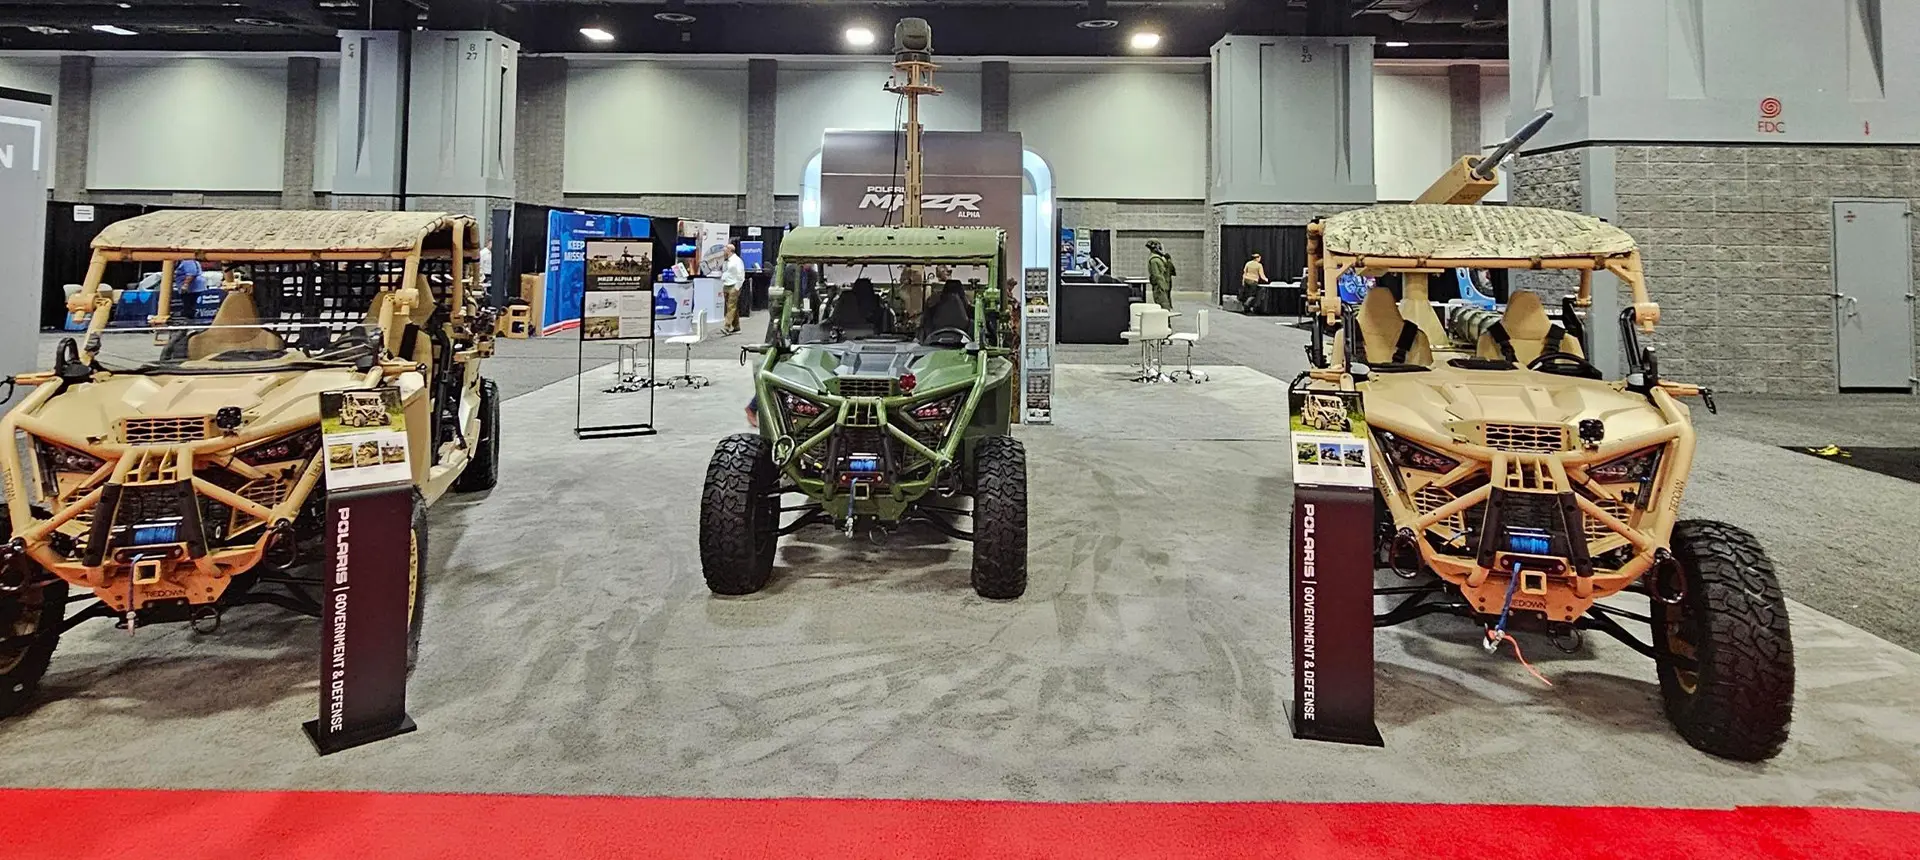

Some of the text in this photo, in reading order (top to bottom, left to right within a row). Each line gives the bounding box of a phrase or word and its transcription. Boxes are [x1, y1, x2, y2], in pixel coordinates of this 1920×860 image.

[466, 52, 478, 60] 27
[1301, 54, 1313, 63] 23
[1758, 121, 1785, 133] FDC
[567, 241, 585, 250] KEEP
[335, 507, 350, 585] POLARIS
[1303, 504, 1315, 578] POLARIS
[1510, 599, 1547, 609] IEDOWN
[1303, 587, 1315, 660] GOVERNMENT
[332, 593, 348, 669] GOVERNMENT
[1303, 661, 1315, 669] &
[332, 669, 345, 680] &
[1303, 670, 1315, 721] DEFENSE
[330, 680, 344, 733] DEFENSE
